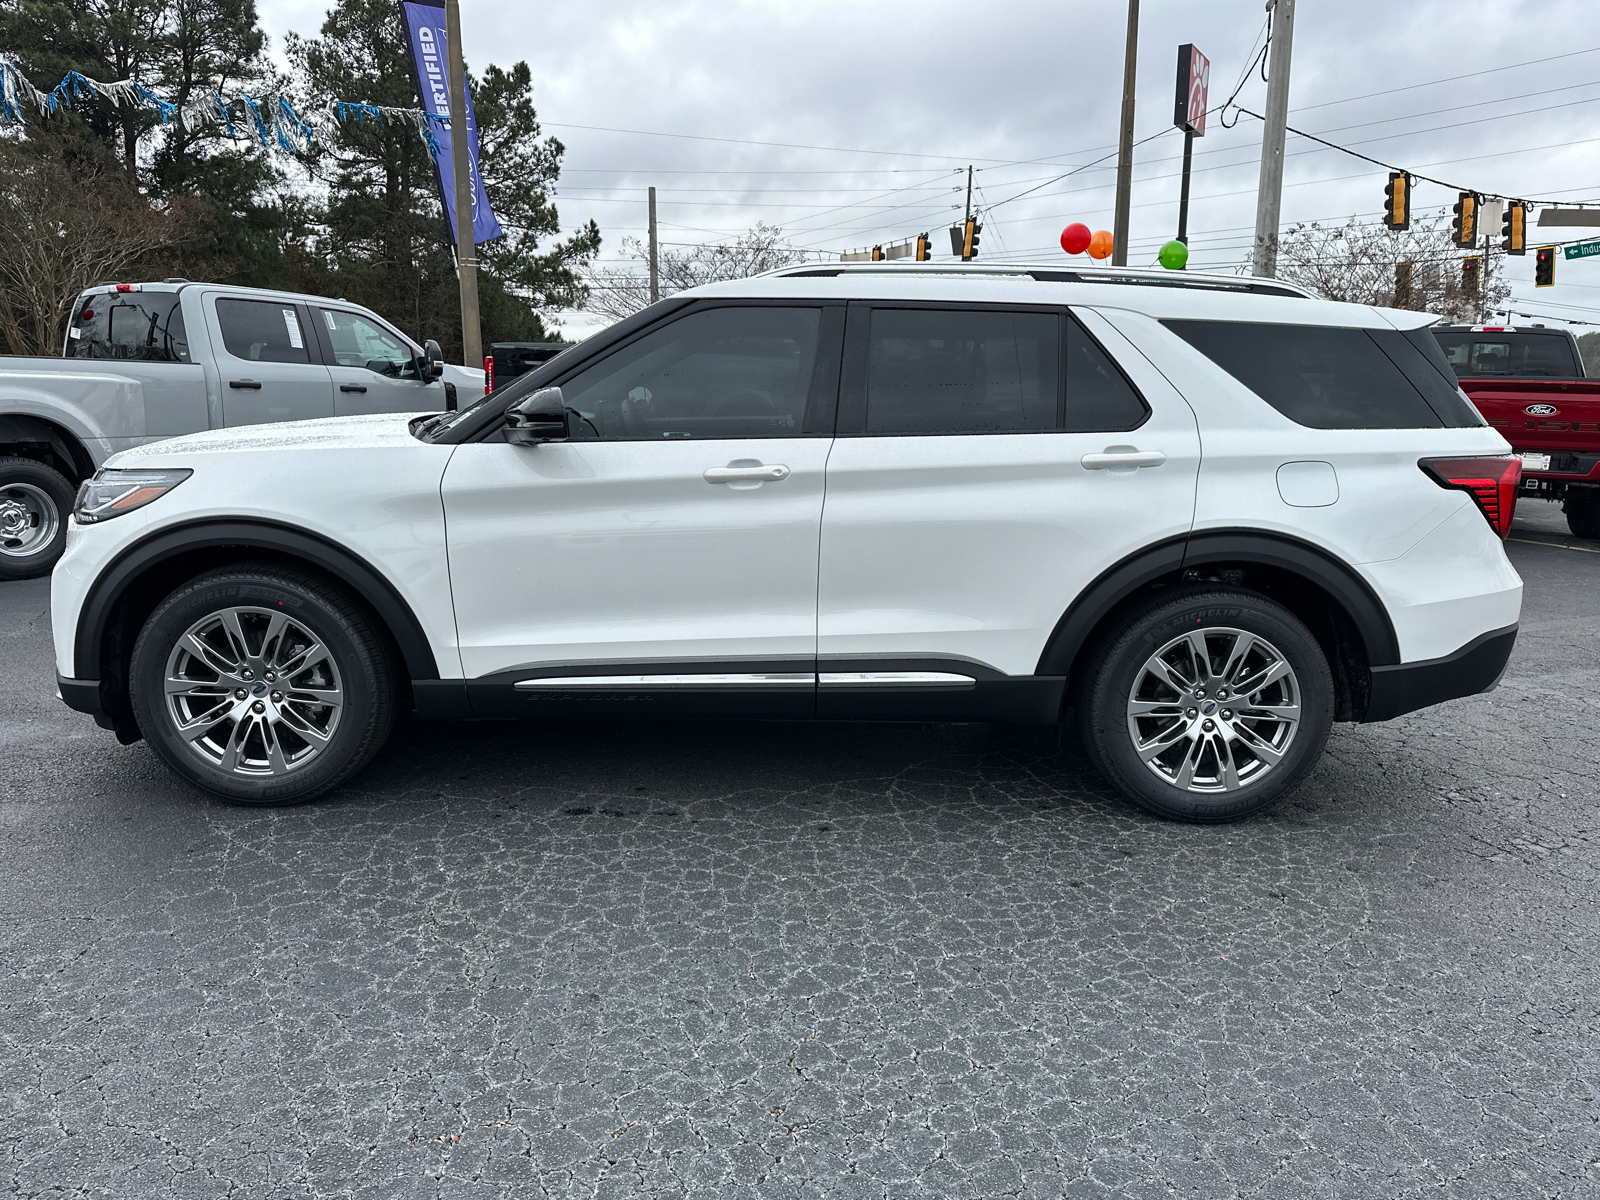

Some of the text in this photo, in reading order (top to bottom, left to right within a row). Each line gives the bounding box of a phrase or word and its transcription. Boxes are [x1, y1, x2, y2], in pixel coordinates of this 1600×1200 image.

[175, 587, 237, 617] MICHELIN
[1173, 609, 1239, 627] MICHELIN
[526, 693, 655, 701] EXPLORER
